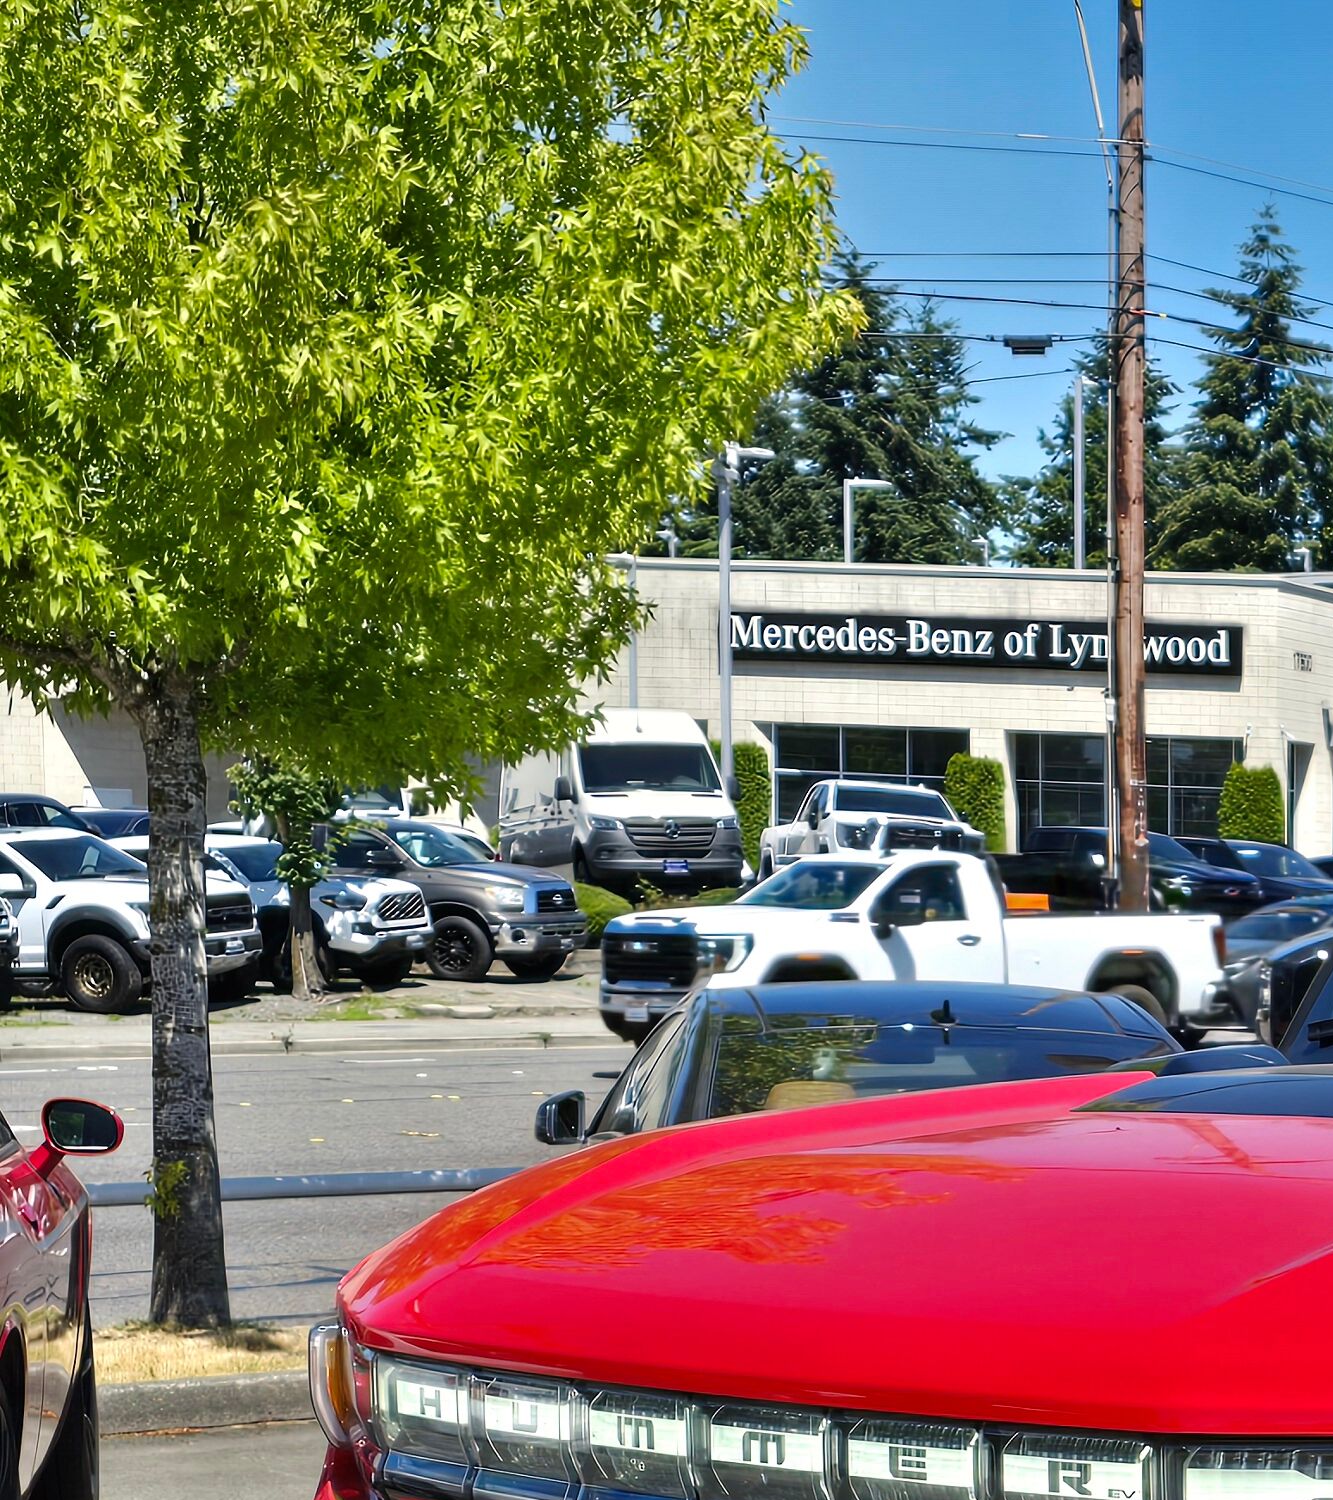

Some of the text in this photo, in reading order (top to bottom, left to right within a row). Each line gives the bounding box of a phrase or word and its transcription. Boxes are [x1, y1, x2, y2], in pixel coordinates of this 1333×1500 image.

[730, 614, 1231, 668] Mercedes-Benz of Lynwood
